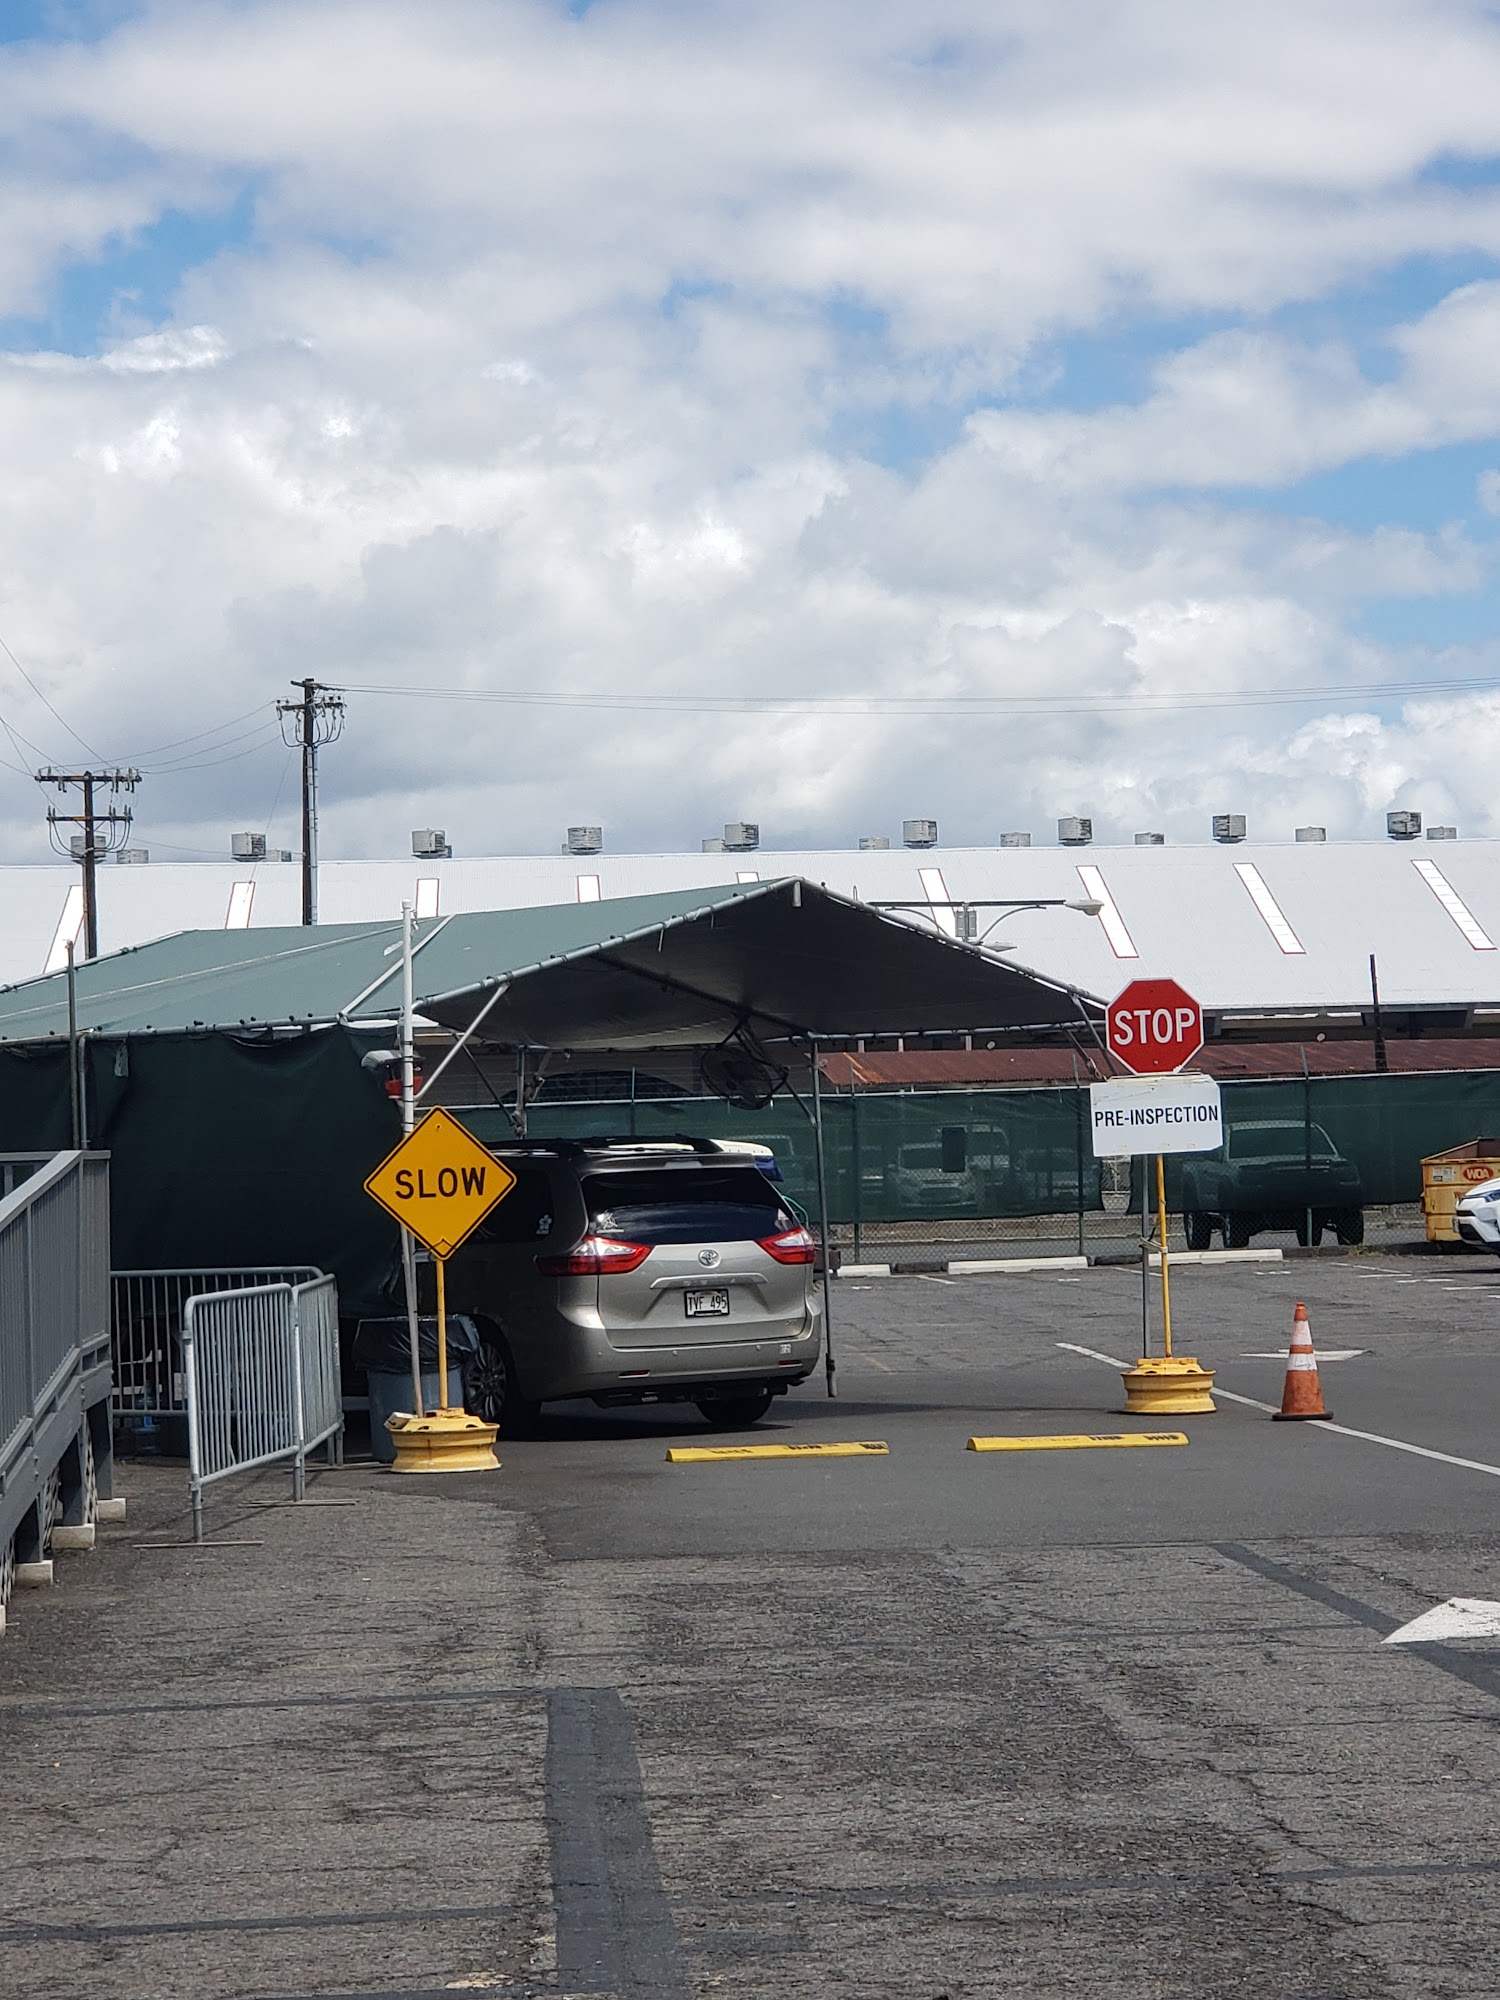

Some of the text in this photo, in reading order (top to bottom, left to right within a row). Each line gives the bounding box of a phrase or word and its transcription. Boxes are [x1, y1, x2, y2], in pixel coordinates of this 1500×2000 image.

[1114, 1008, 1195, 1046] STOP
[1094, 1105, 1219, 1127] PRE-INSPECTION
[395, 1167, 486, 1199] SLOW
[710, 1295, 727, 1309] 495
